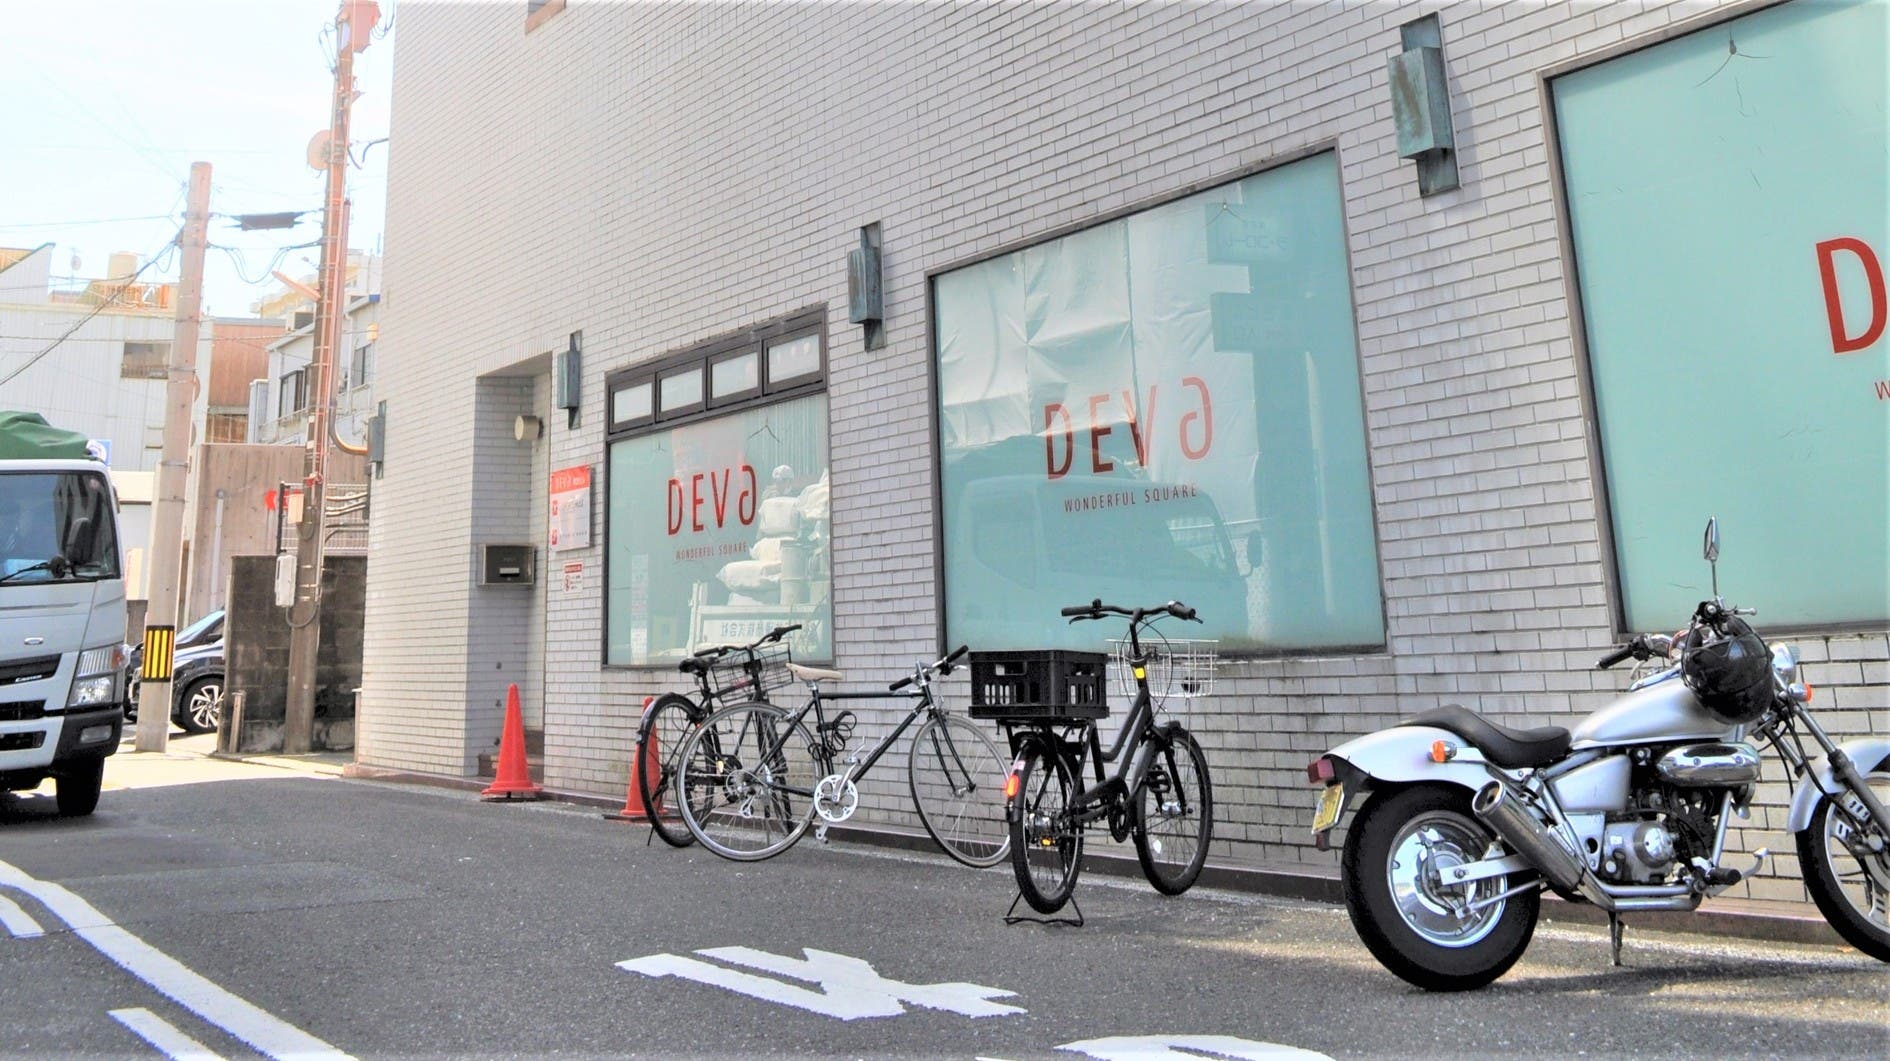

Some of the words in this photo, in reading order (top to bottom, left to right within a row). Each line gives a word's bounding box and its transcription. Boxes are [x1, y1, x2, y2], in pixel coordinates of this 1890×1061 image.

[1816, 237, 1888, 354] D
[1064, 493, 1137, 512] WONDERFUL
[1145, 484, 1197, 503] SQUARE
[676, 546, 715, 561] WONDERFUL
[719, 541, 748, 556] SQUARE
